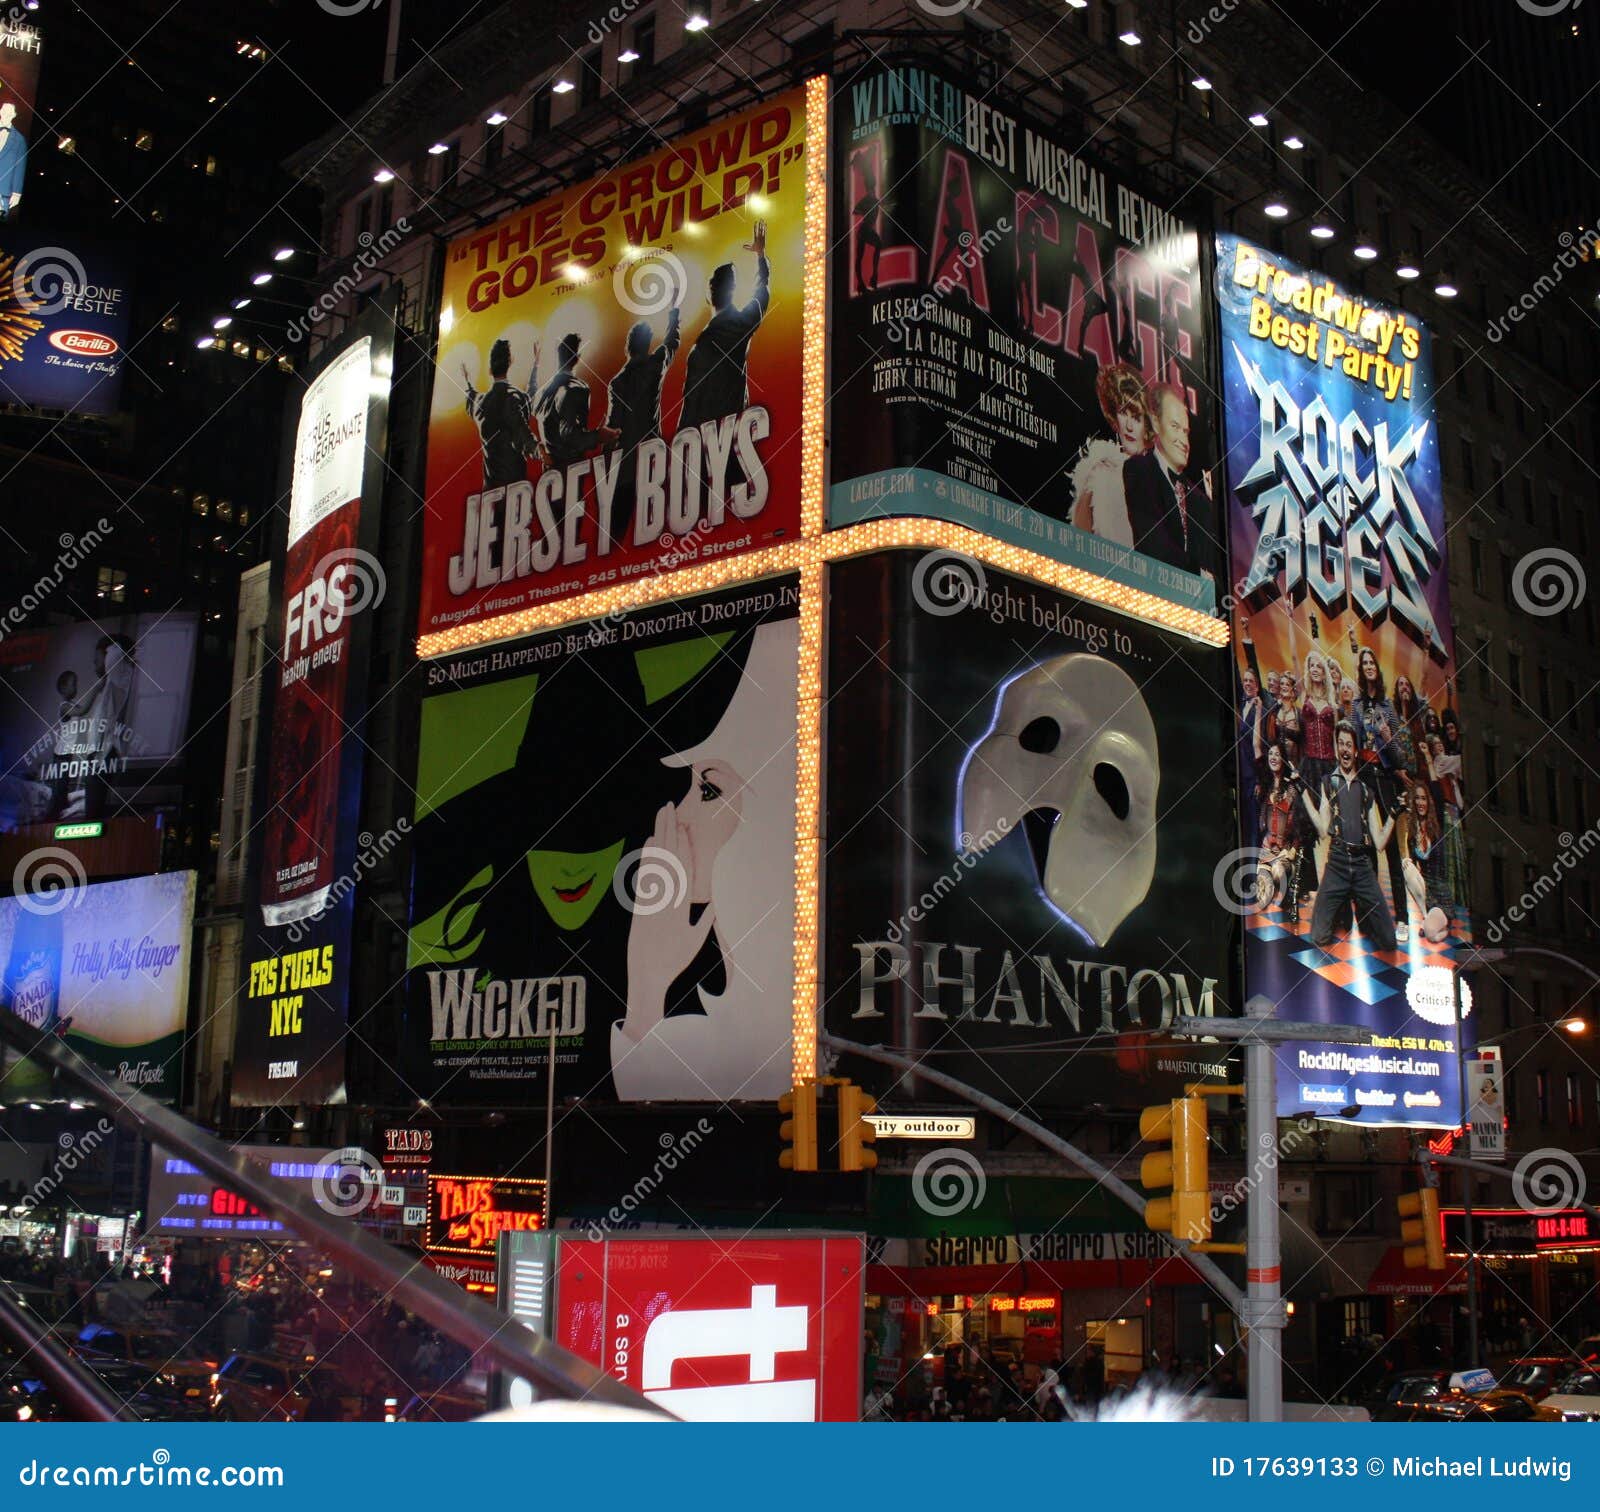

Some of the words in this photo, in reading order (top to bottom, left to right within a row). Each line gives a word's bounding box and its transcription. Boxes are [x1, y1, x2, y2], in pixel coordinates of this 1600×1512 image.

[852, 68, 963, 134] WINNER!
[853, 121, 880, 141] 2010
[882, 113, 919, 128] TONY
[579, 106, 793, 226] CROWD
[966, 95, 1016, 174] BEST
[1025, 129, 1112, 229] MUSICAL
[466, 227, 606, 313] GOES
[849, 142, 990, 313] LA
[1015, 189, 1196, 415] CAGE
[62, 281, 123, 302] BUONE
[64, 296, 117, 316] FESTE.
[65, 335, 110, 351] Barilla
[873, 298, 919, 324] KELSEY
[925, 301, 972, 338] GRAMMER
[988, 329, 1025, 364] DOUGLAS
[1030, 349, 1056, 378] HODGE
[1249, 297, 1320, 363] Best
[1324, 329, 1414, 402] Party!
[44, 355, 60, 365] The
[62, 358, 84, 369] choice
[85, 362, 96, 374] of
[874, 358, 902, 371] MUSIC
[915, 359, 946, 373] LYRICS
[906, 328, 922, 351] LA
[930, 333, 958, 364] CAGE
[963, 347, 984, 377] AUX
[990, 358, 1028, 396] FOLLES
[873, 368, 907, 392] JERRY
[915, 368, 957, 399] HERMAN
[1005, 394, 1023, 408] BOOK
[980, 392, 1013, 423] HARVEY
[1015, 409, 1058, 444] FIERSTEIN
[998, 424, 1015, 438] JEAN
[952, 430, 974, 454] LYNNE
[976, 440, 992, 460] PAGE
[1232, 340, 1440, 552] ROCK
[946, 460, 966, 481] TERRY
[969, 468, 998, 494] JOHNSON
[447, 449, 624, 598] JERSEY
[633, 406, 771, 547] BOYS
[951, 484, 990, 516] LONGACRE
[1029, 518, 1044, 538] 220
[1326, 483, 1358, 519] OF
[439, 603, 481, 625] August
[483, 593, 525, 611] Wilson
[529, 578, 584, 600] Theatre,
[587, 567, 617, 586] 245
[620, 558, 656, 578] West
[700, 534, 752, 556] Street
[1241, 481, 1448, 658] AGES
[284, 564, 347, 663] FRS
[943, 566, 1028, 624] Tonight
[1032, 601, 1110, 653] belongs
[491, 643, 562, 672] HAPPENED
[623, 609, 697, 641] DOROTHY
[701, 592, 775, 623] DROPPED
[281, 656, 310, 688] healthy
[312, 636, 345, 669] energy
[39, 757, 129, 781] IMPORTANT
[58, 824, 98, 837] LAMAR
[71, 942, 104, 983] Holly
[135, 936, 181, 978] Ginger
[249, 957, 280, 998] FRS
[280, 944, 334, 993] FUELS
[851, 941, 1220, 1044] PHANTOM
[25, 1000, 45, 1024] DRY
[269, 994, 303, 1037] NYC
[446, 1041, 475, 1050] UNTOLD
[572, 1037, 584, 1047] OZ
[1402, 1037, 1417, 1050] 256
[1428, 1039, 1445, 1052] 47th
[119, 1061, 140, 1083] Real
[268, 1061, 297, 1079] FRS.COM
[524, 1055, 541, 1065] WEST
[555, 1054, 579, 1065] STREET
[1164, 1058, 1198, 1075] MAJESTIC
[1199, 1062, 1227, 1078] THEATRE
[1299, 1050, 1440, 1076] RockOfAgesMusical.com
[904, 1121, 960, 1133] outdoor
[1472, 1121, 1502, 1135] MAMMA
[385, 1190, 400, 1201] CAPS
[408, 1210, 423, 1221] CAPS
[470, 1211, 542, 1248] STEAKS
[1537, 1217, 1588, 1238] BAR-B-QUE
[925, 1233, 1008, 1266] sbarro
[1029, 1232, 1104, 1261] sbarro
[992, 1297, 1015, 1312] Pasta
[1018, 1297, 1056, 1312] Espresso
[616, 1313, 630, 1329] a
